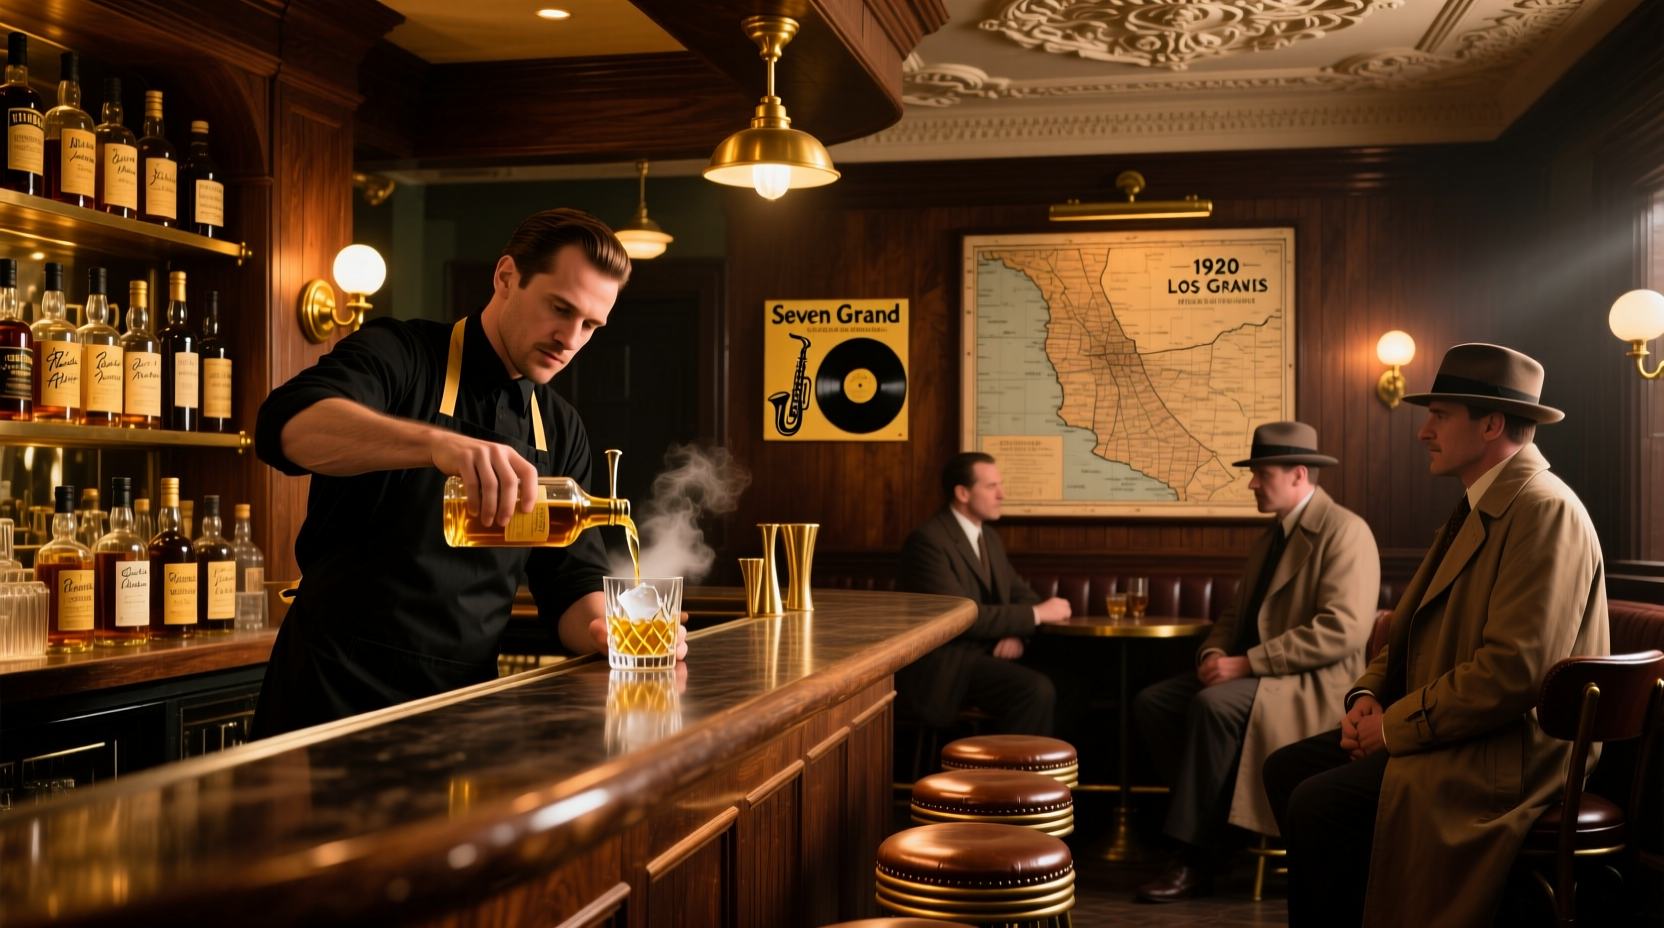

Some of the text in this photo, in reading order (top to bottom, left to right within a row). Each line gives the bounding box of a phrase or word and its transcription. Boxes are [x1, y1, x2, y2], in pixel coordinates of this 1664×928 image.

[1193, 258, 1239, 275] 1920
[1168, 279, 1200, 294] LOS
[772, 303, 900, 325] Seven Grand
